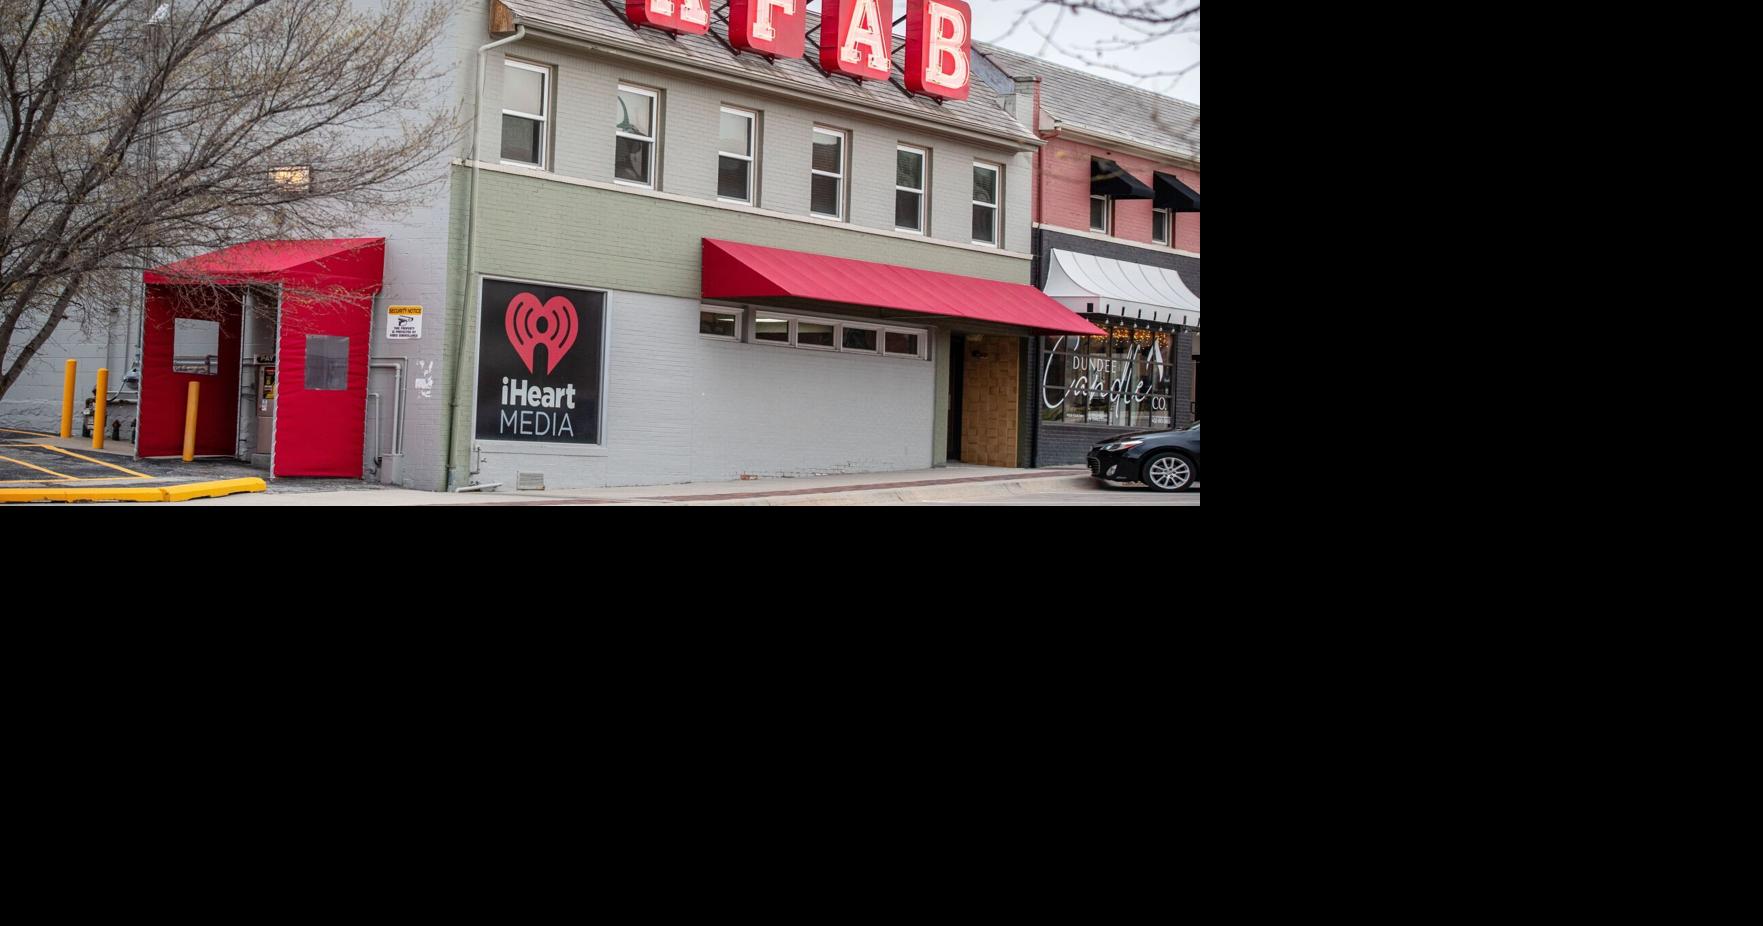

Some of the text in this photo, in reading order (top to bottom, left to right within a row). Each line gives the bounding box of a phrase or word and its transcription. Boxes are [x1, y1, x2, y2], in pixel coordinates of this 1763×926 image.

[1072, 355, 1117, 374] DUNDEE
[501, 376, 576, 409] iHeart
[1152, 396, 1168, 411] CO.
[500, 409, 574, 437] MEDIA
